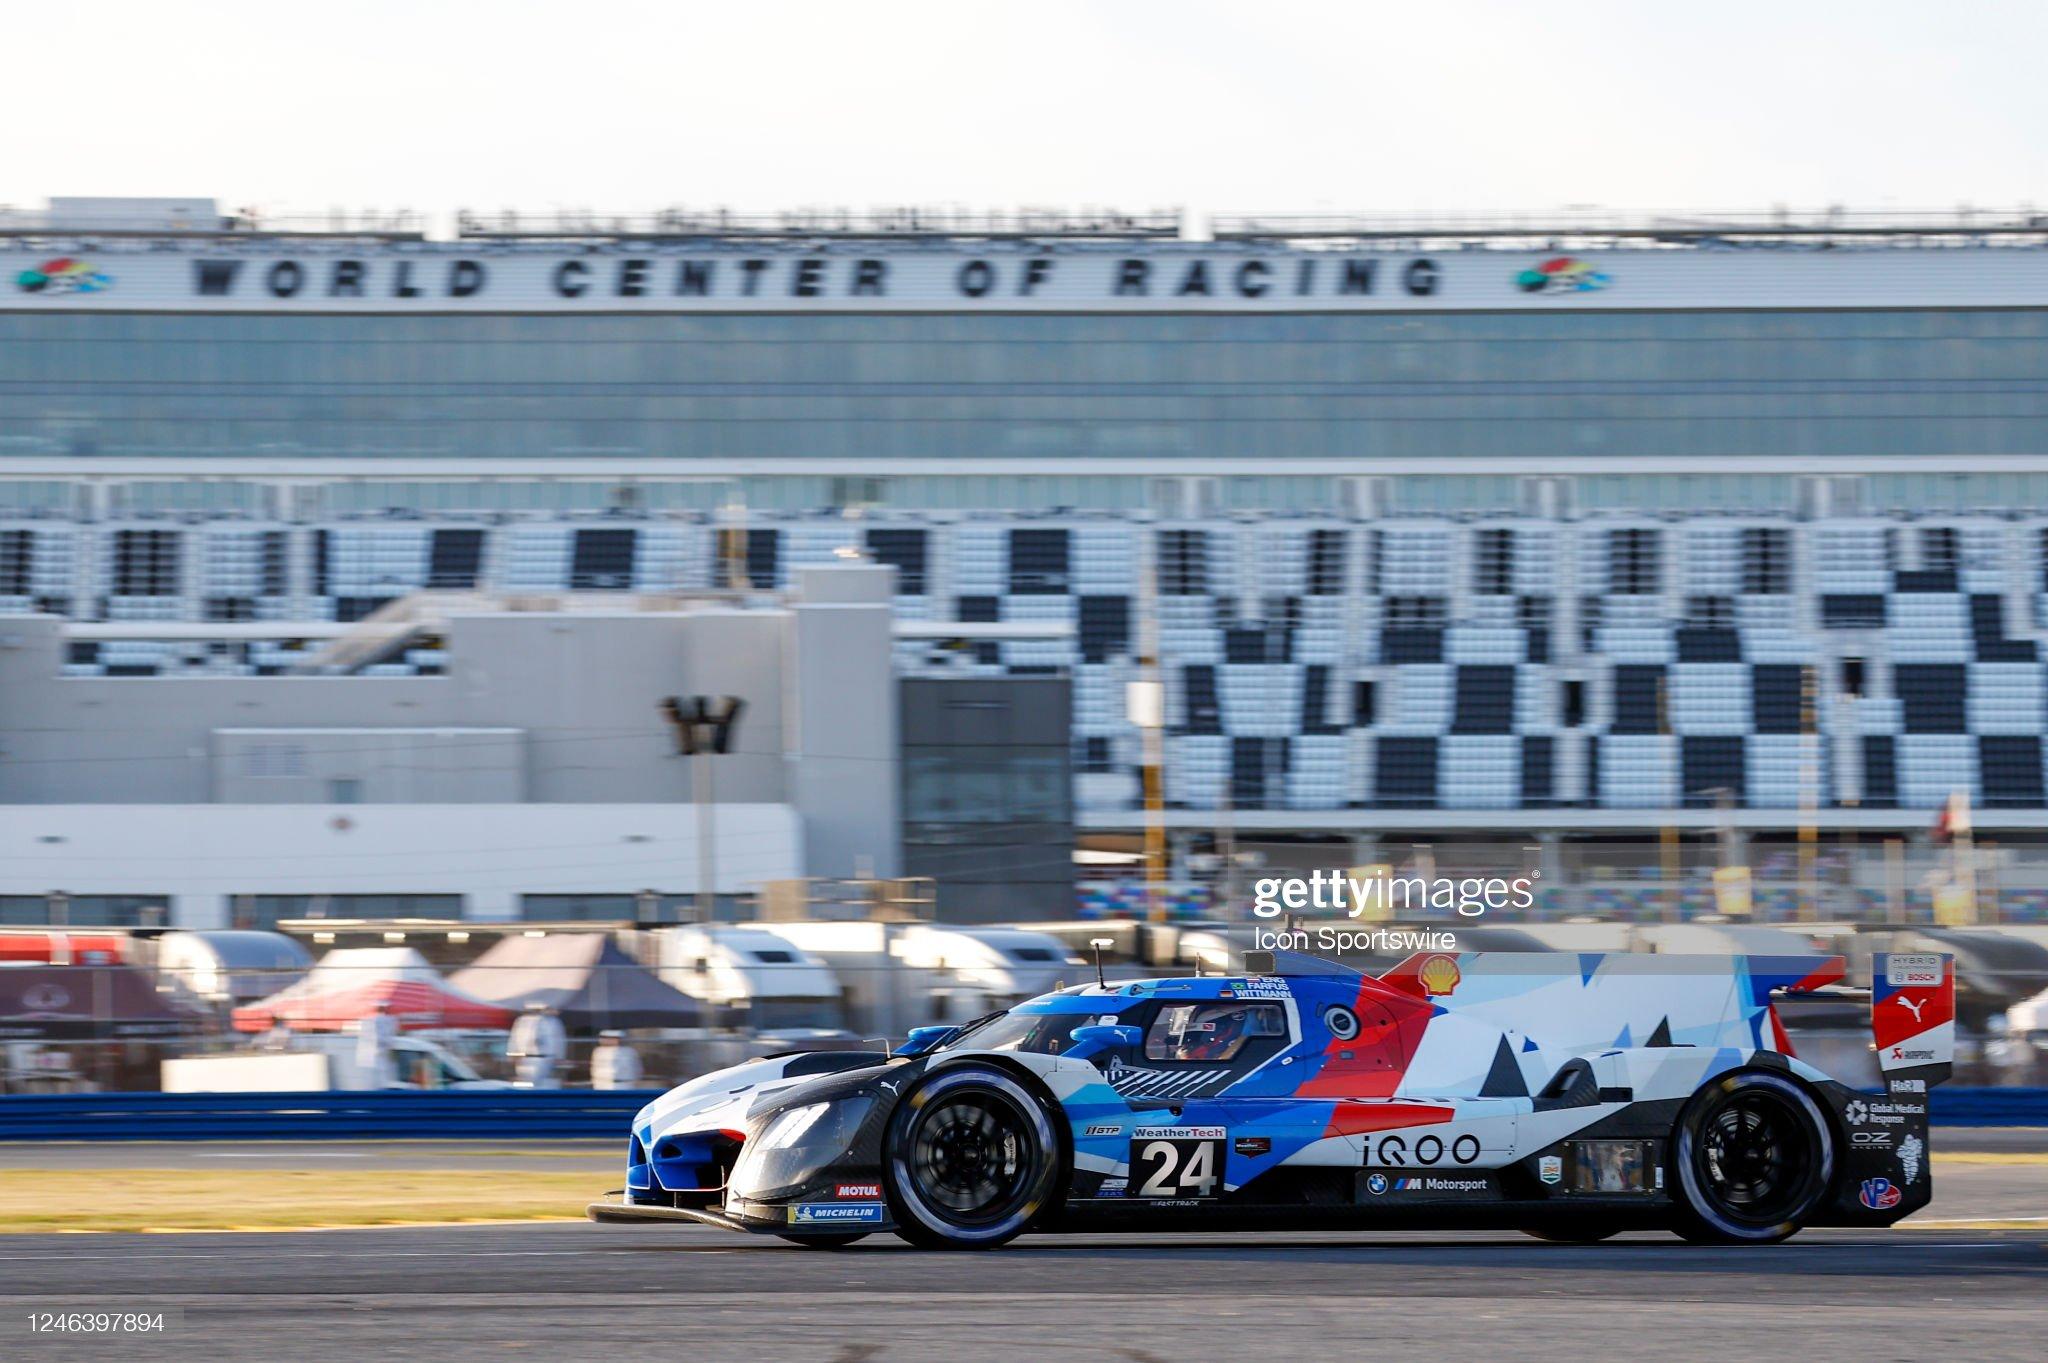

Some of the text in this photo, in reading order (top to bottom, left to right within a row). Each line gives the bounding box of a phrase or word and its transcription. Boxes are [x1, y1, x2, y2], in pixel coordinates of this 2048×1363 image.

[190, 258, 1443, 298] WORLD CENTER OF RACING
[1893, 957, 1936, 965] HYBRID
[1907, 973, 1936, 981] BOSCH
[1247, 982, 1289, 991] FARFUS
[1235, 989, 1292, 998] WITTMANN
[1870, 1103, 1925, 1114] Global Medical
[1869, 1113, 1905, 1124] Response
[1134, 1128, 1224, 1137] WeatherTech
[1363, 1134, 1480, 1166] iQOO
[1139, 1141, 1217, 1197] 24
[1426, 1178, 1487, 1191] Motorsport
[838, 1186, 878, 1196] MOTUL
[815, 1208, 874, 1217] MICHELIN
